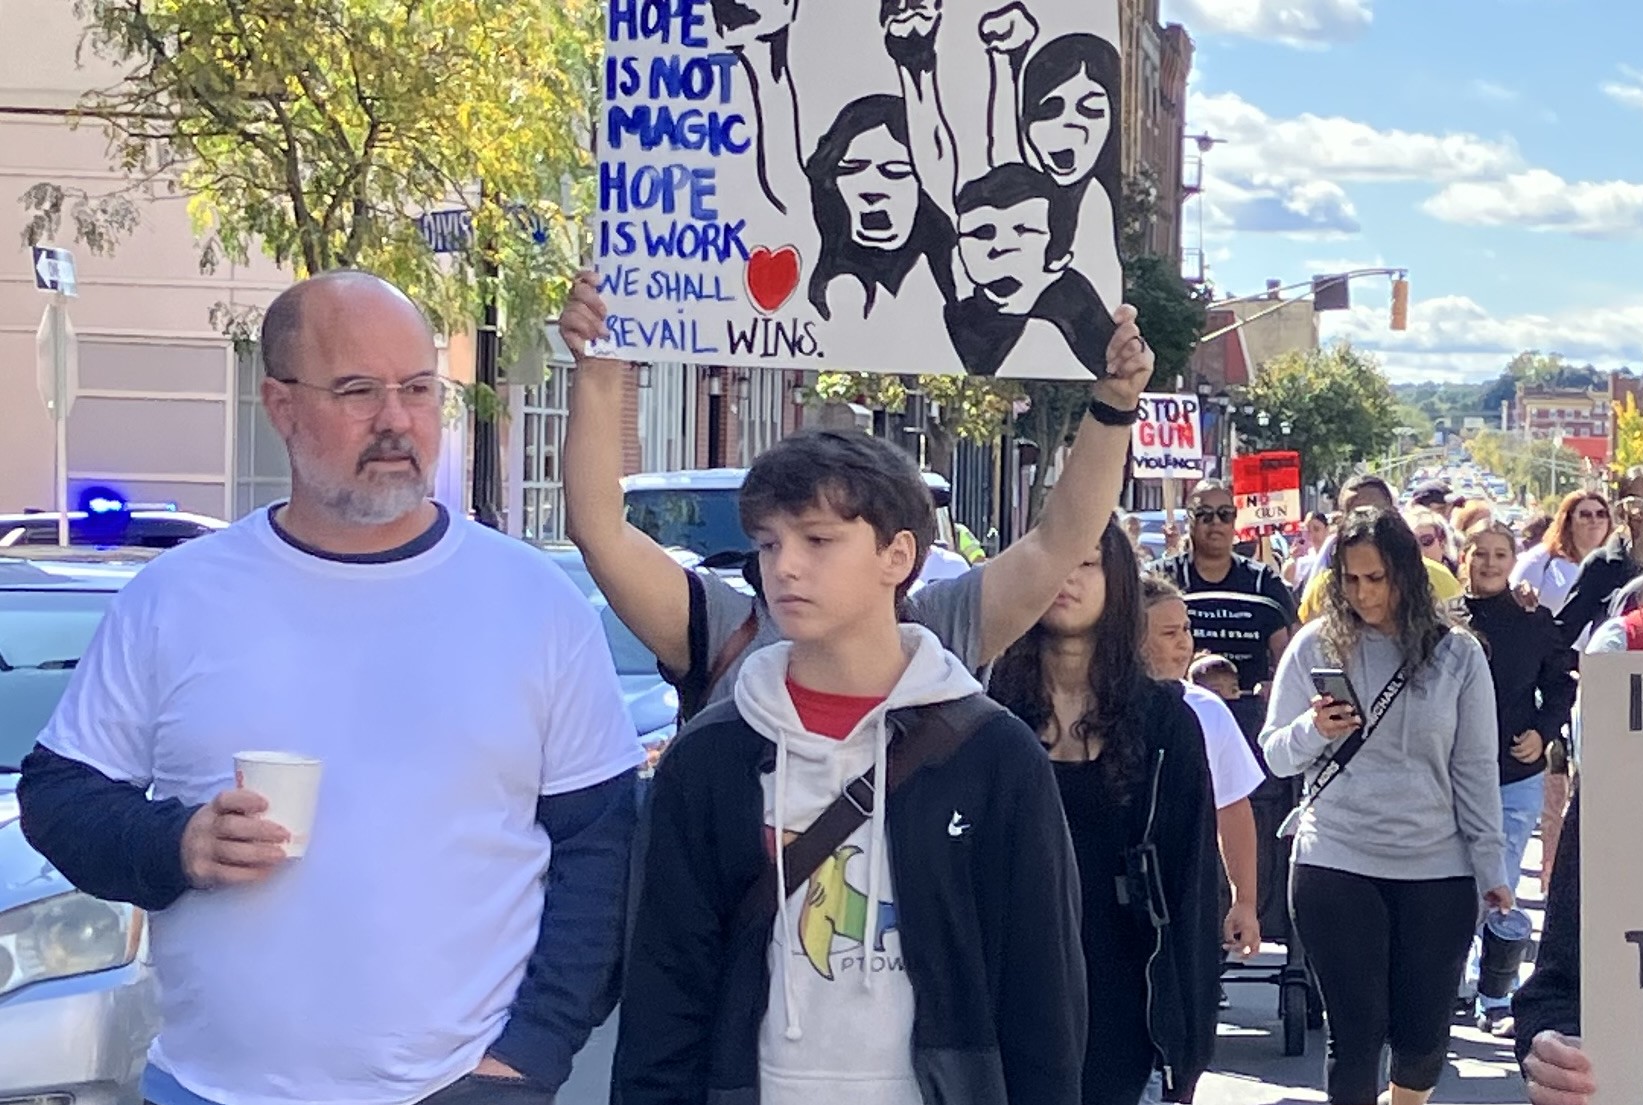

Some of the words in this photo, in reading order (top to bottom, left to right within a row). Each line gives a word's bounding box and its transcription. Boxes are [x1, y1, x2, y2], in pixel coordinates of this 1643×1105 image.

[607, 0, 709, 48] HOPE
[606, 55, 641, 101] IS
[649, 53, 742, 104] NOT
[607, 105, 751, 157] MAGIC
[600, 161, 718, 221] HOPE
[600, 220, 637, 258] IS
[643, 218, 751, 264] WORK
[594, 264, 641, 296] WE
[646, 270, 736, 302] SHALL
[1137, 397, 1197, 424] STOP
[1139, 422, 1195, 449] GUN
